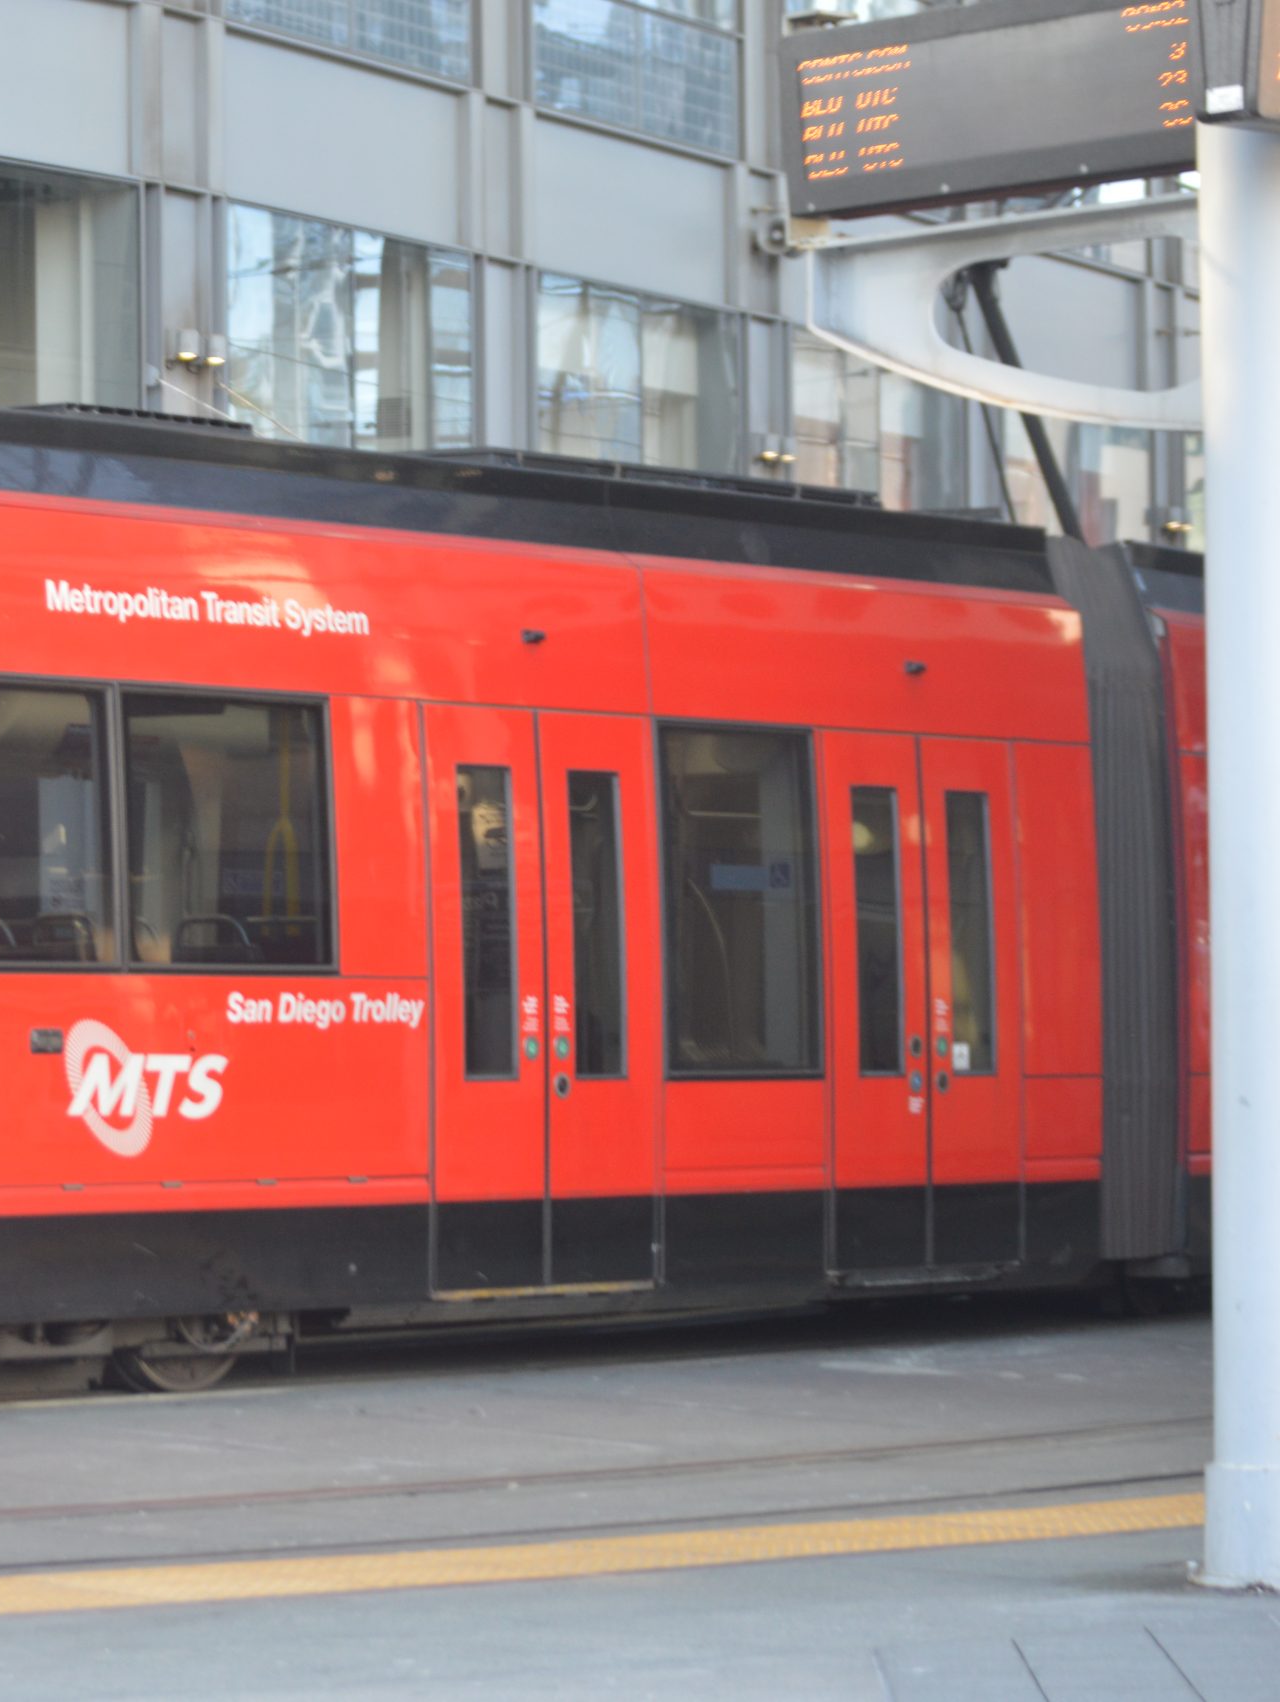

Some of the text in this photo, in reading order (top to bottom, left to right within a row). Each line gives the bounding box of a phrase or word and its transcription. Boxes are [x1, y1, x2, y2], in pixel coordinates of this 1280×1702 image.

[45, 579, 370, 637] Metropolitan Transit System
[227, 992, 425, 1029] San Diego Trolley
[66, 1053, 230, 1120] MTS
